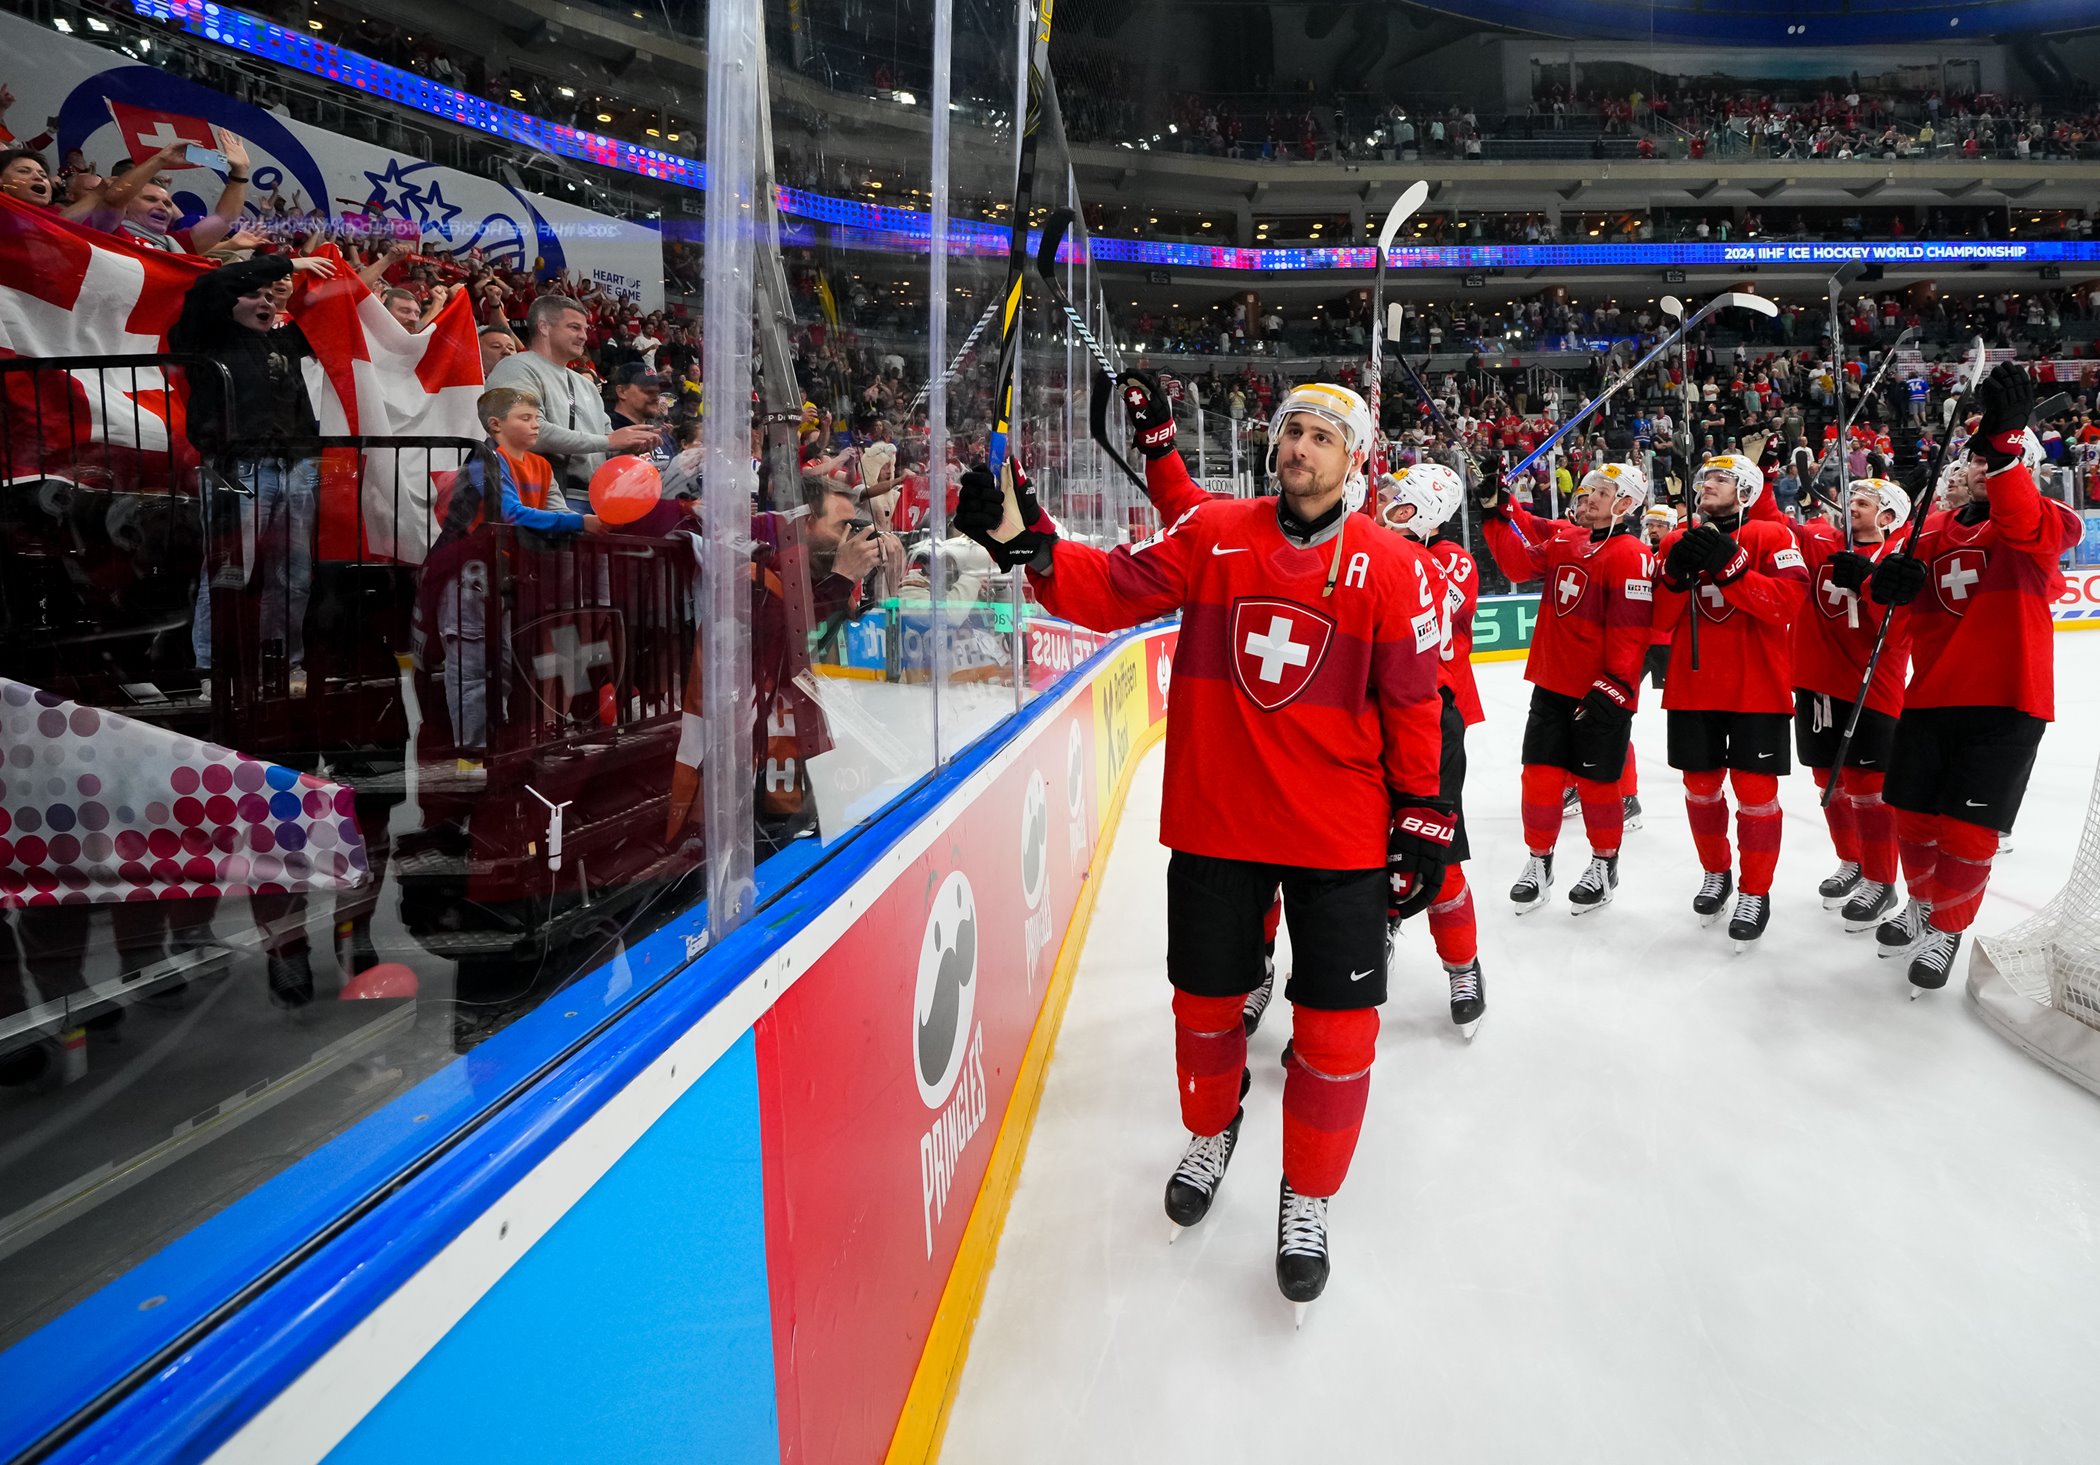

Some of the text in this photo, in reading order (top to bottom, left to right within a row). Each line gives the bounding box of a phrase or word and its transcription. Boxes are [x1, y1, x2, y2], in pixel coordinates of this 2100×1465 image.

[1724, 246, 2027, 260] 2024 IIHF ICE HOCKEY WORLD CHAMPIONSHIP
[593, 269, 641, 290] HEART OF
[615, 287, 641, 302] GAME
[1345, 552, 1370, 589] A
[1448, 589, 1462, 605] SOT
[1401, 816, 1455, 842] BAU
[920, 1020, 987, 1262] PRINGLES
